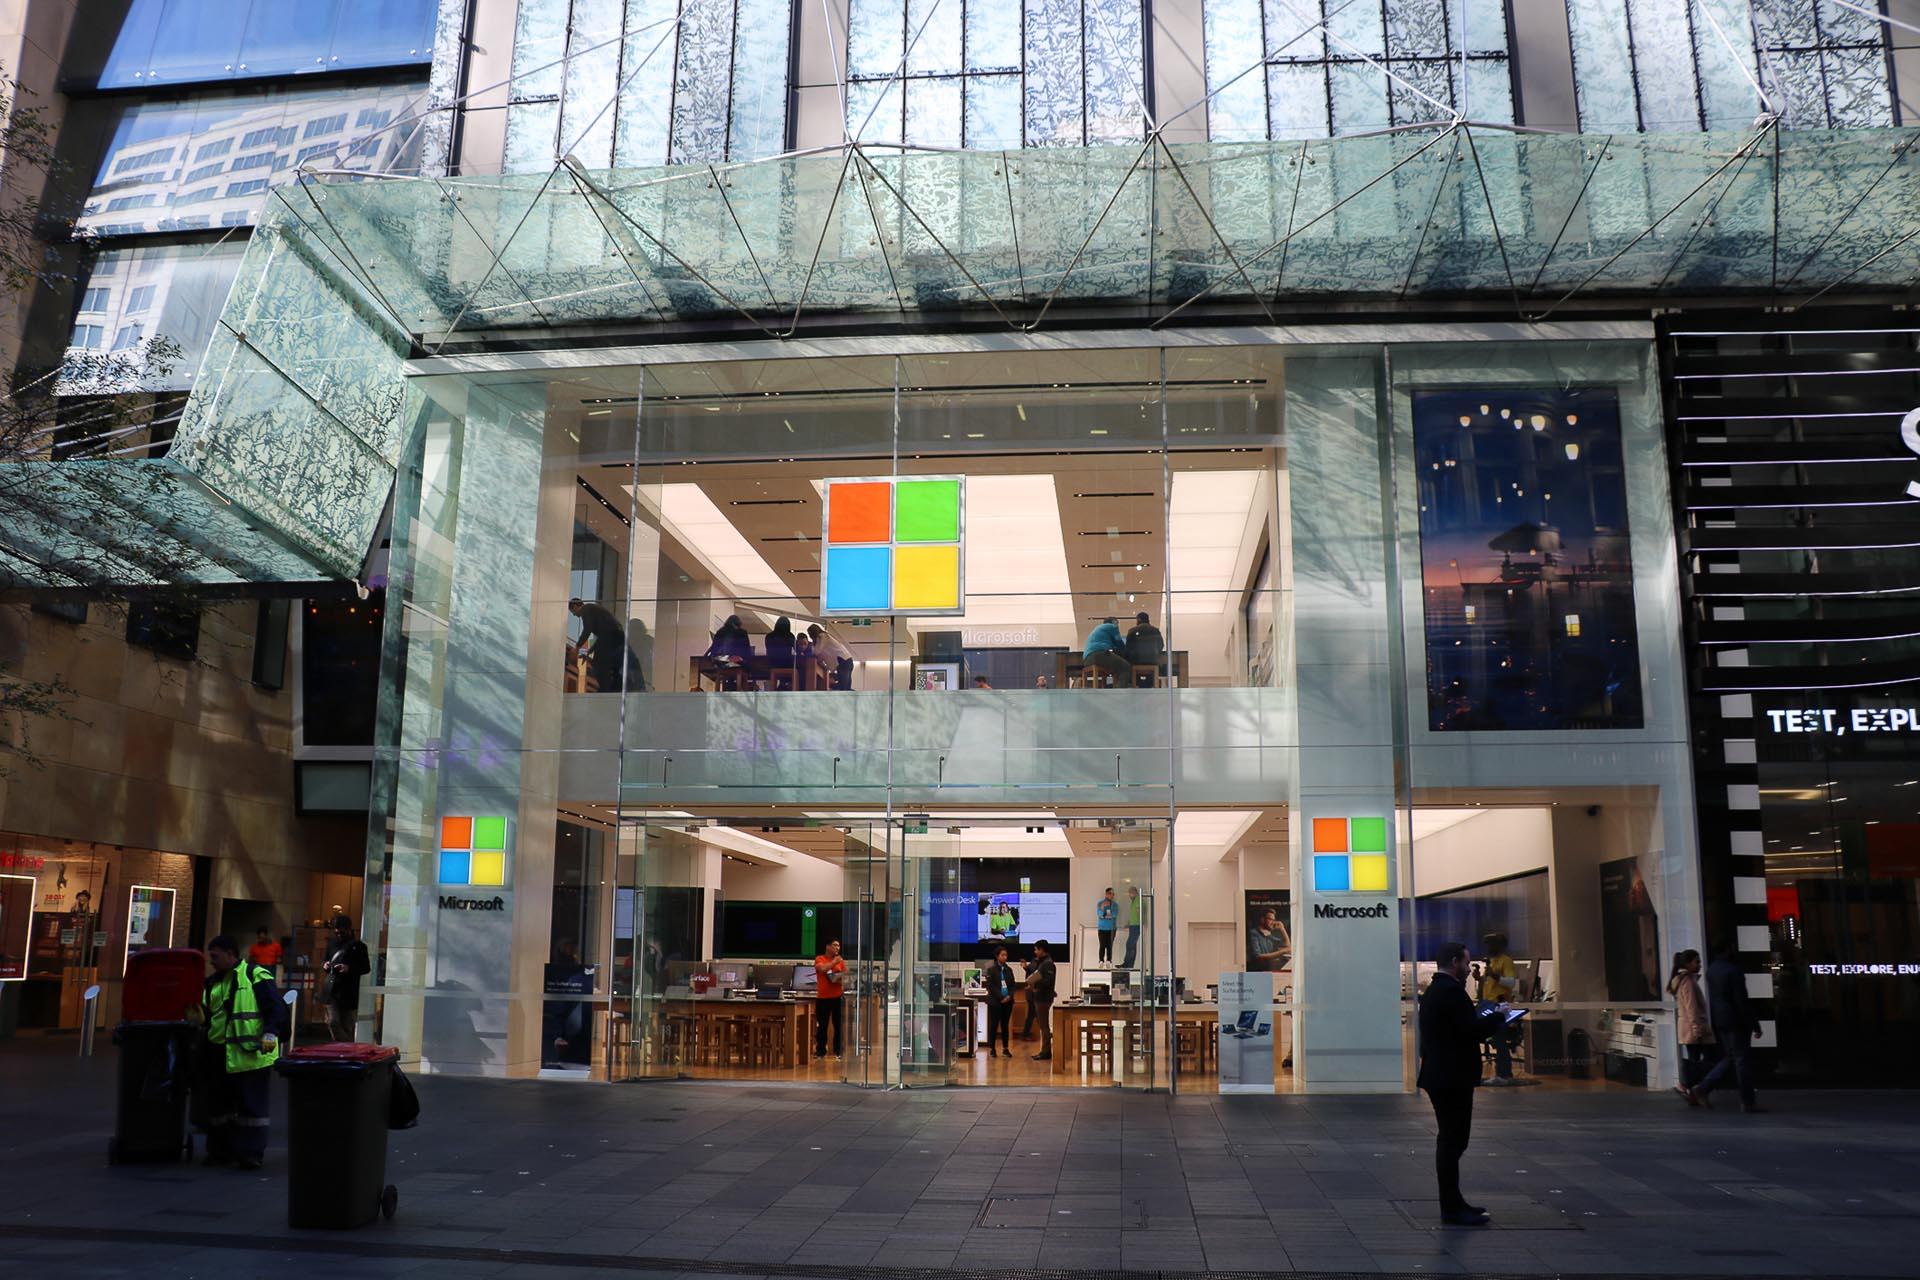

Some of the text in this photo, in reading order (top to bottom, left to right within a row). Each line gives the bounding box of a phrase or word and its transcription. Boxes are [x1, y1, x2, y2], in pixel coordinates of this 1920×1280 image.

[1766, 709, 1845, 736] TEST,
[439, 896, 504, 912] Microsoft
[926, 895, 976, 904] Answer Desk
[1314, 902, 1389, 918] Microsoft
[1809, 964, 1920, 976] TEST, EXPLORE, ENJ
